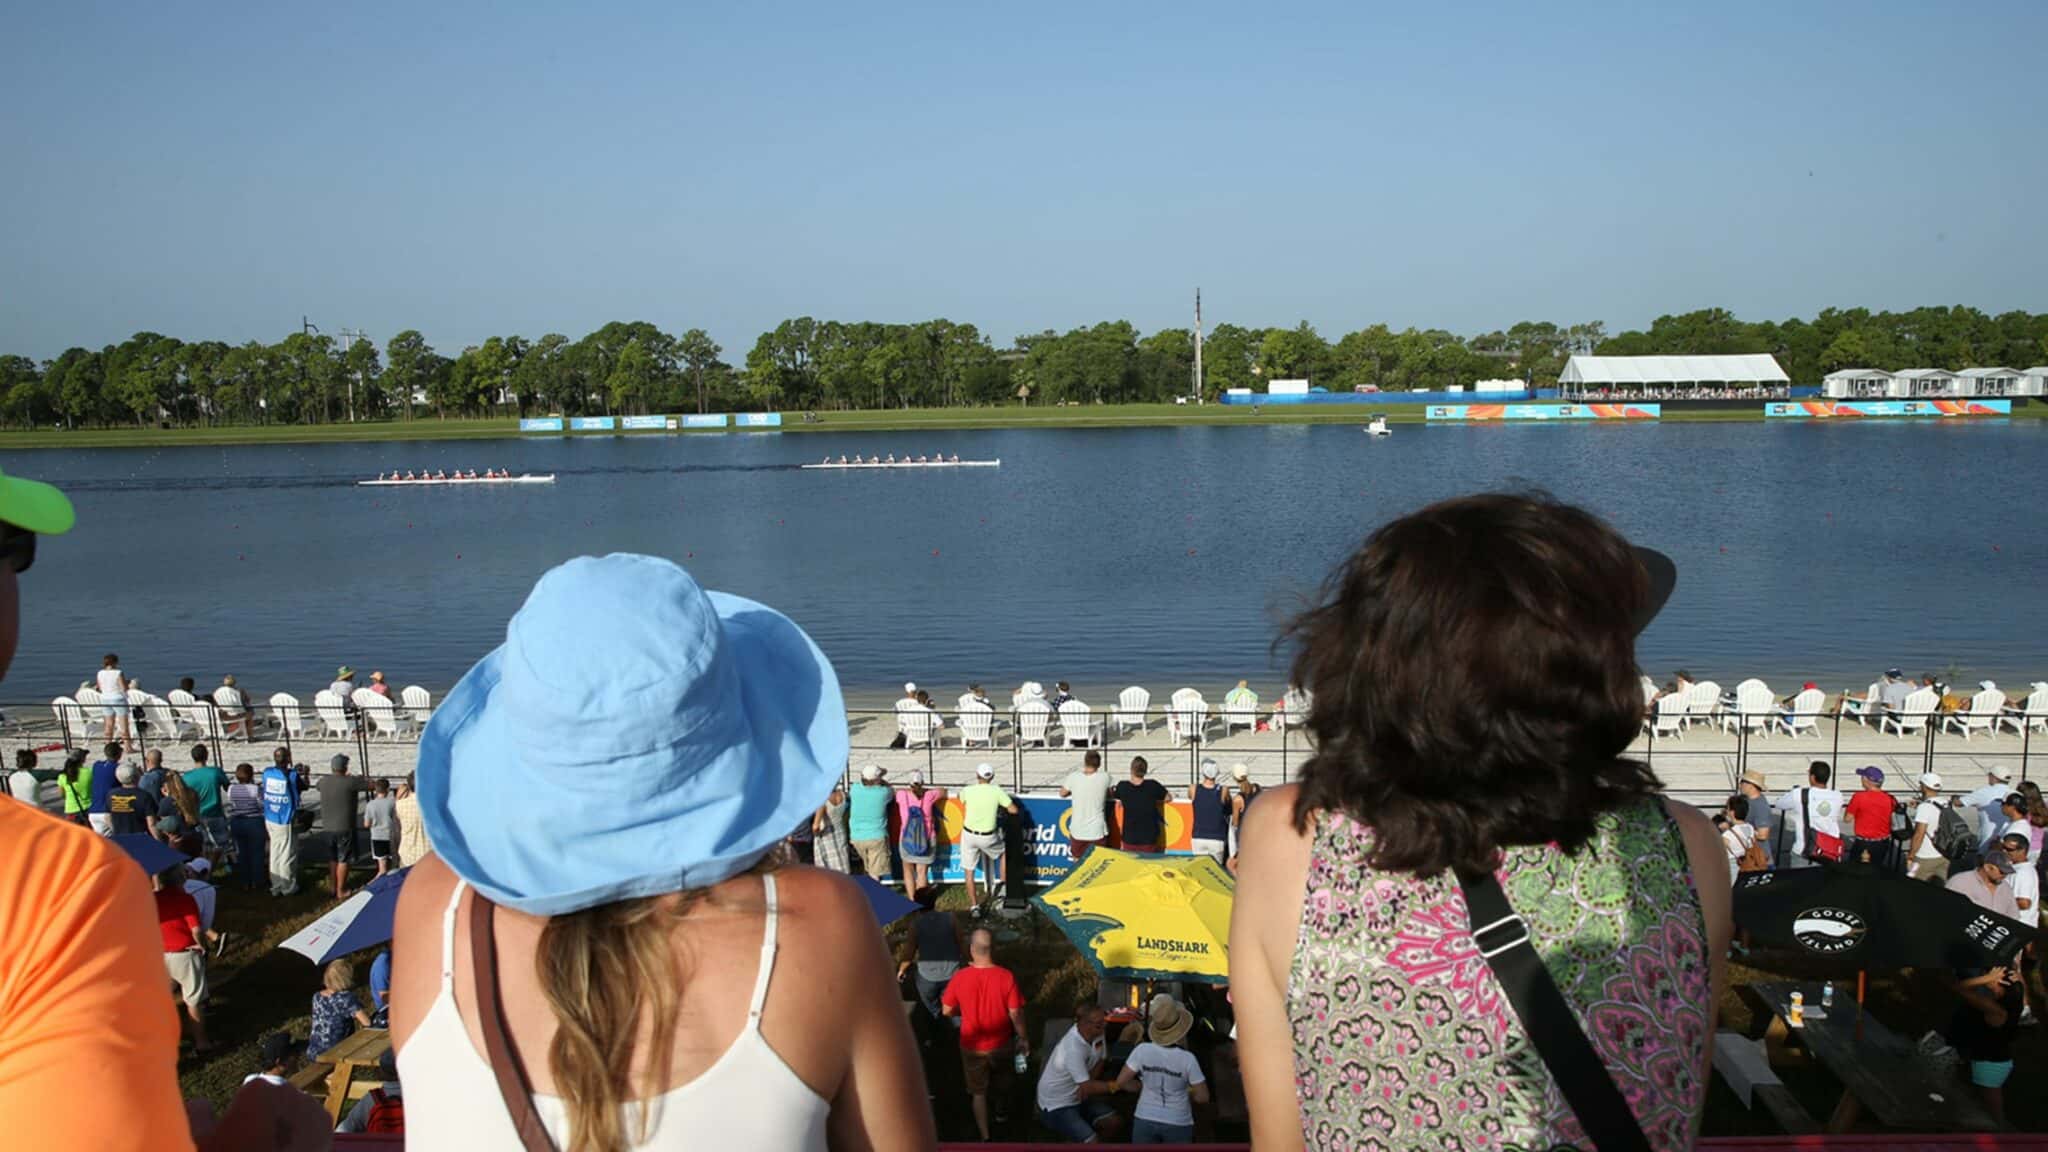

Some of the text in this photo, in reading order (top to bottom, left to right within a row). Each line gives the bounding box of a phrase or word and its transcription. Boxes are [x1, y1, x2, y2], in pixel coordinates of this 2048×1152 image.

[264, 793, 289, 804] PHOTO
[1024, 842, 1075, 861] owing
[1811, 910, 1860, 926] GOOSE
[1136, 936, 1209, 954] LANDSHARK
[1801, 935, 1854, 951] ISLAND
